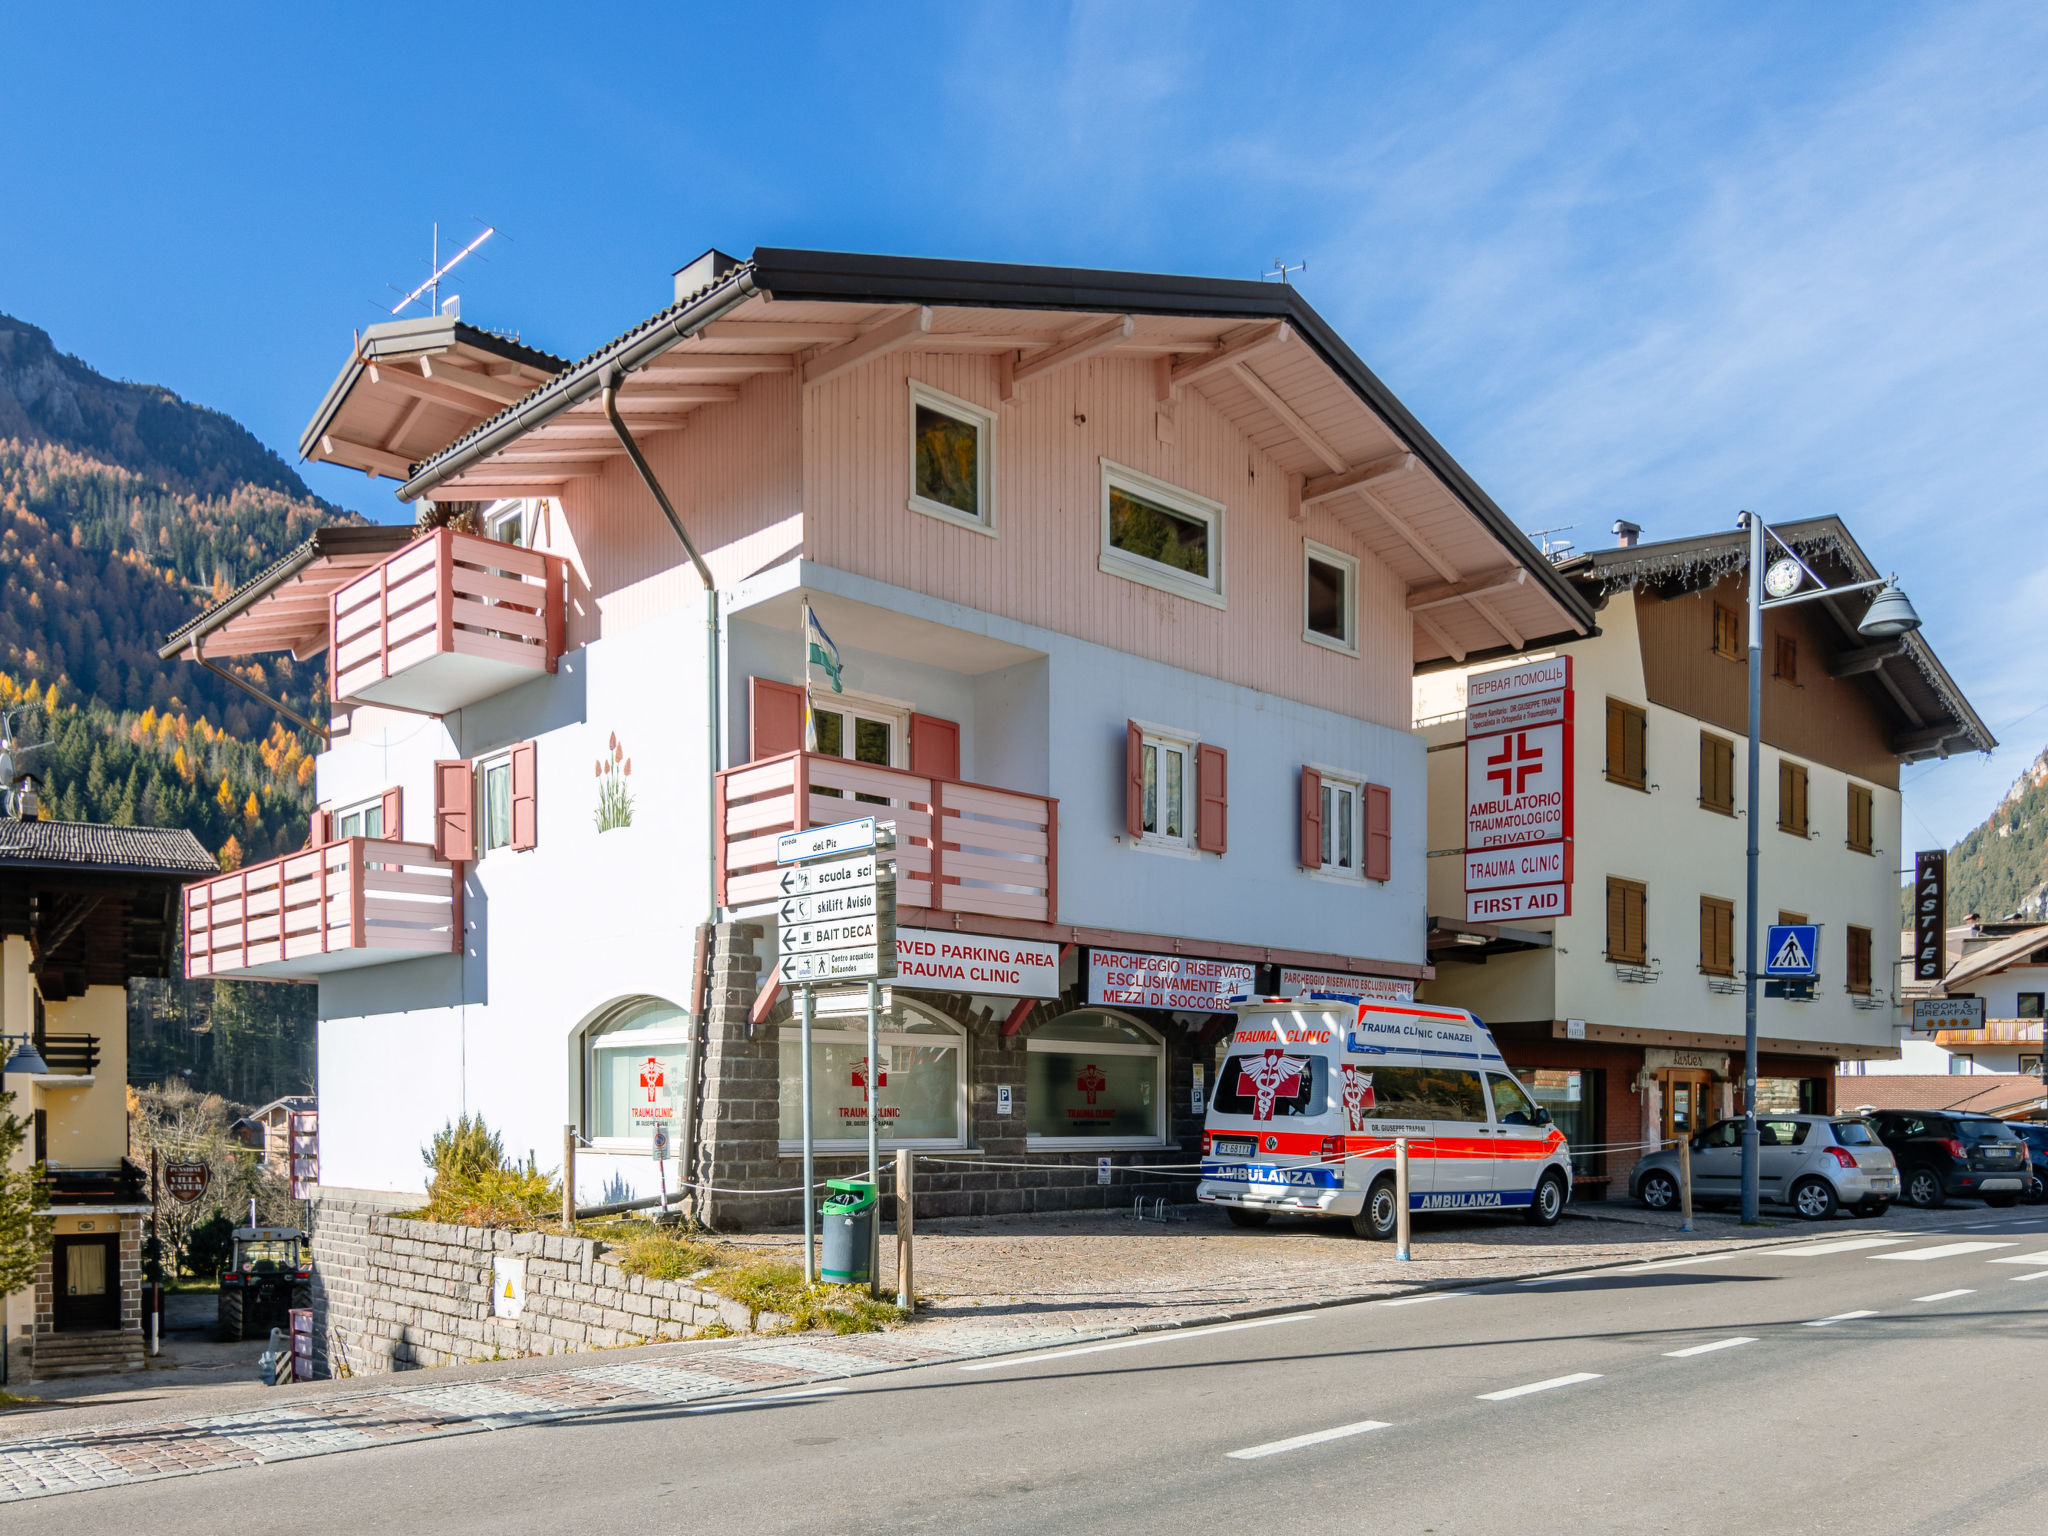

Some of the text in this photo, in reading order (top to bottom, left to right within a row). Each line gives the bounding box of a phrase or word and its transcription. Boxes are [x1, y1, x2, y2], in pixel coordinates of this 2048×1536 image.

[1471, 667, 1563, 696] ПЕРВАЯ ПОМОЩЬ
[1469, 792, 1561, 817] AMBULATORIO
[1469, 809, 1561, 832] TRAUMATOLOGICO
[812, 839, 837, 852] del Piz
[1483, 829, 1545, 846] PRIVATO
[819, 863, 872, 884] scuola sci
[1470, 854, 1560, 879] TRAUMA CLINIC
[817, 894, 872, 914] skilift Avisio
[1473, 893, 1558, 914] FIRST AID
[1920, 867, 1938, 976] LASTIES
[816, 928, 840, 942] BAIT
[831, 953, 849, 963] Centro
[941, 944, 1010, 964] PARKING
[1014, 951, 1055, 967] AREA
[896, 961, 1020, 984] TRAUMA CLINIC
[1093, 953, 1251, 980] PARCHEGGIO RISERVATO
[1107, 972, 1239, 995] ESCLUSIVAMENTE AI
[1283, 971, 1411, 994] PARCHEGGIO RISERVATO ESCLUSIVAMENTE
[1103, 989, 1231, 1011] MEZZI DI SOCCORS
[1924, 1001, 1972, 1010] ROOM &
[1916, 1007, 1980, 1017] BREAKFAST
[1233, 1029, 1331, 1044] TRAUMA CLINIC
[1361, 1022, 1473, 1043] TRAUMA CLINIC CANAZEI
[1673, 1051, 1703, 1067] Lasties
[1001, 1089, 1008, 1099] P
[631, 1107, 674, 1118] TRAUMA CLINIC
[839, 1107, 869, 1118] TRAUM
[170, 1176, 201, 1184] VILLA
[1215, 1166, 1316, 1186] AMBULANZA
[1420, 1193, 1502, 1209] AMBULANZA
